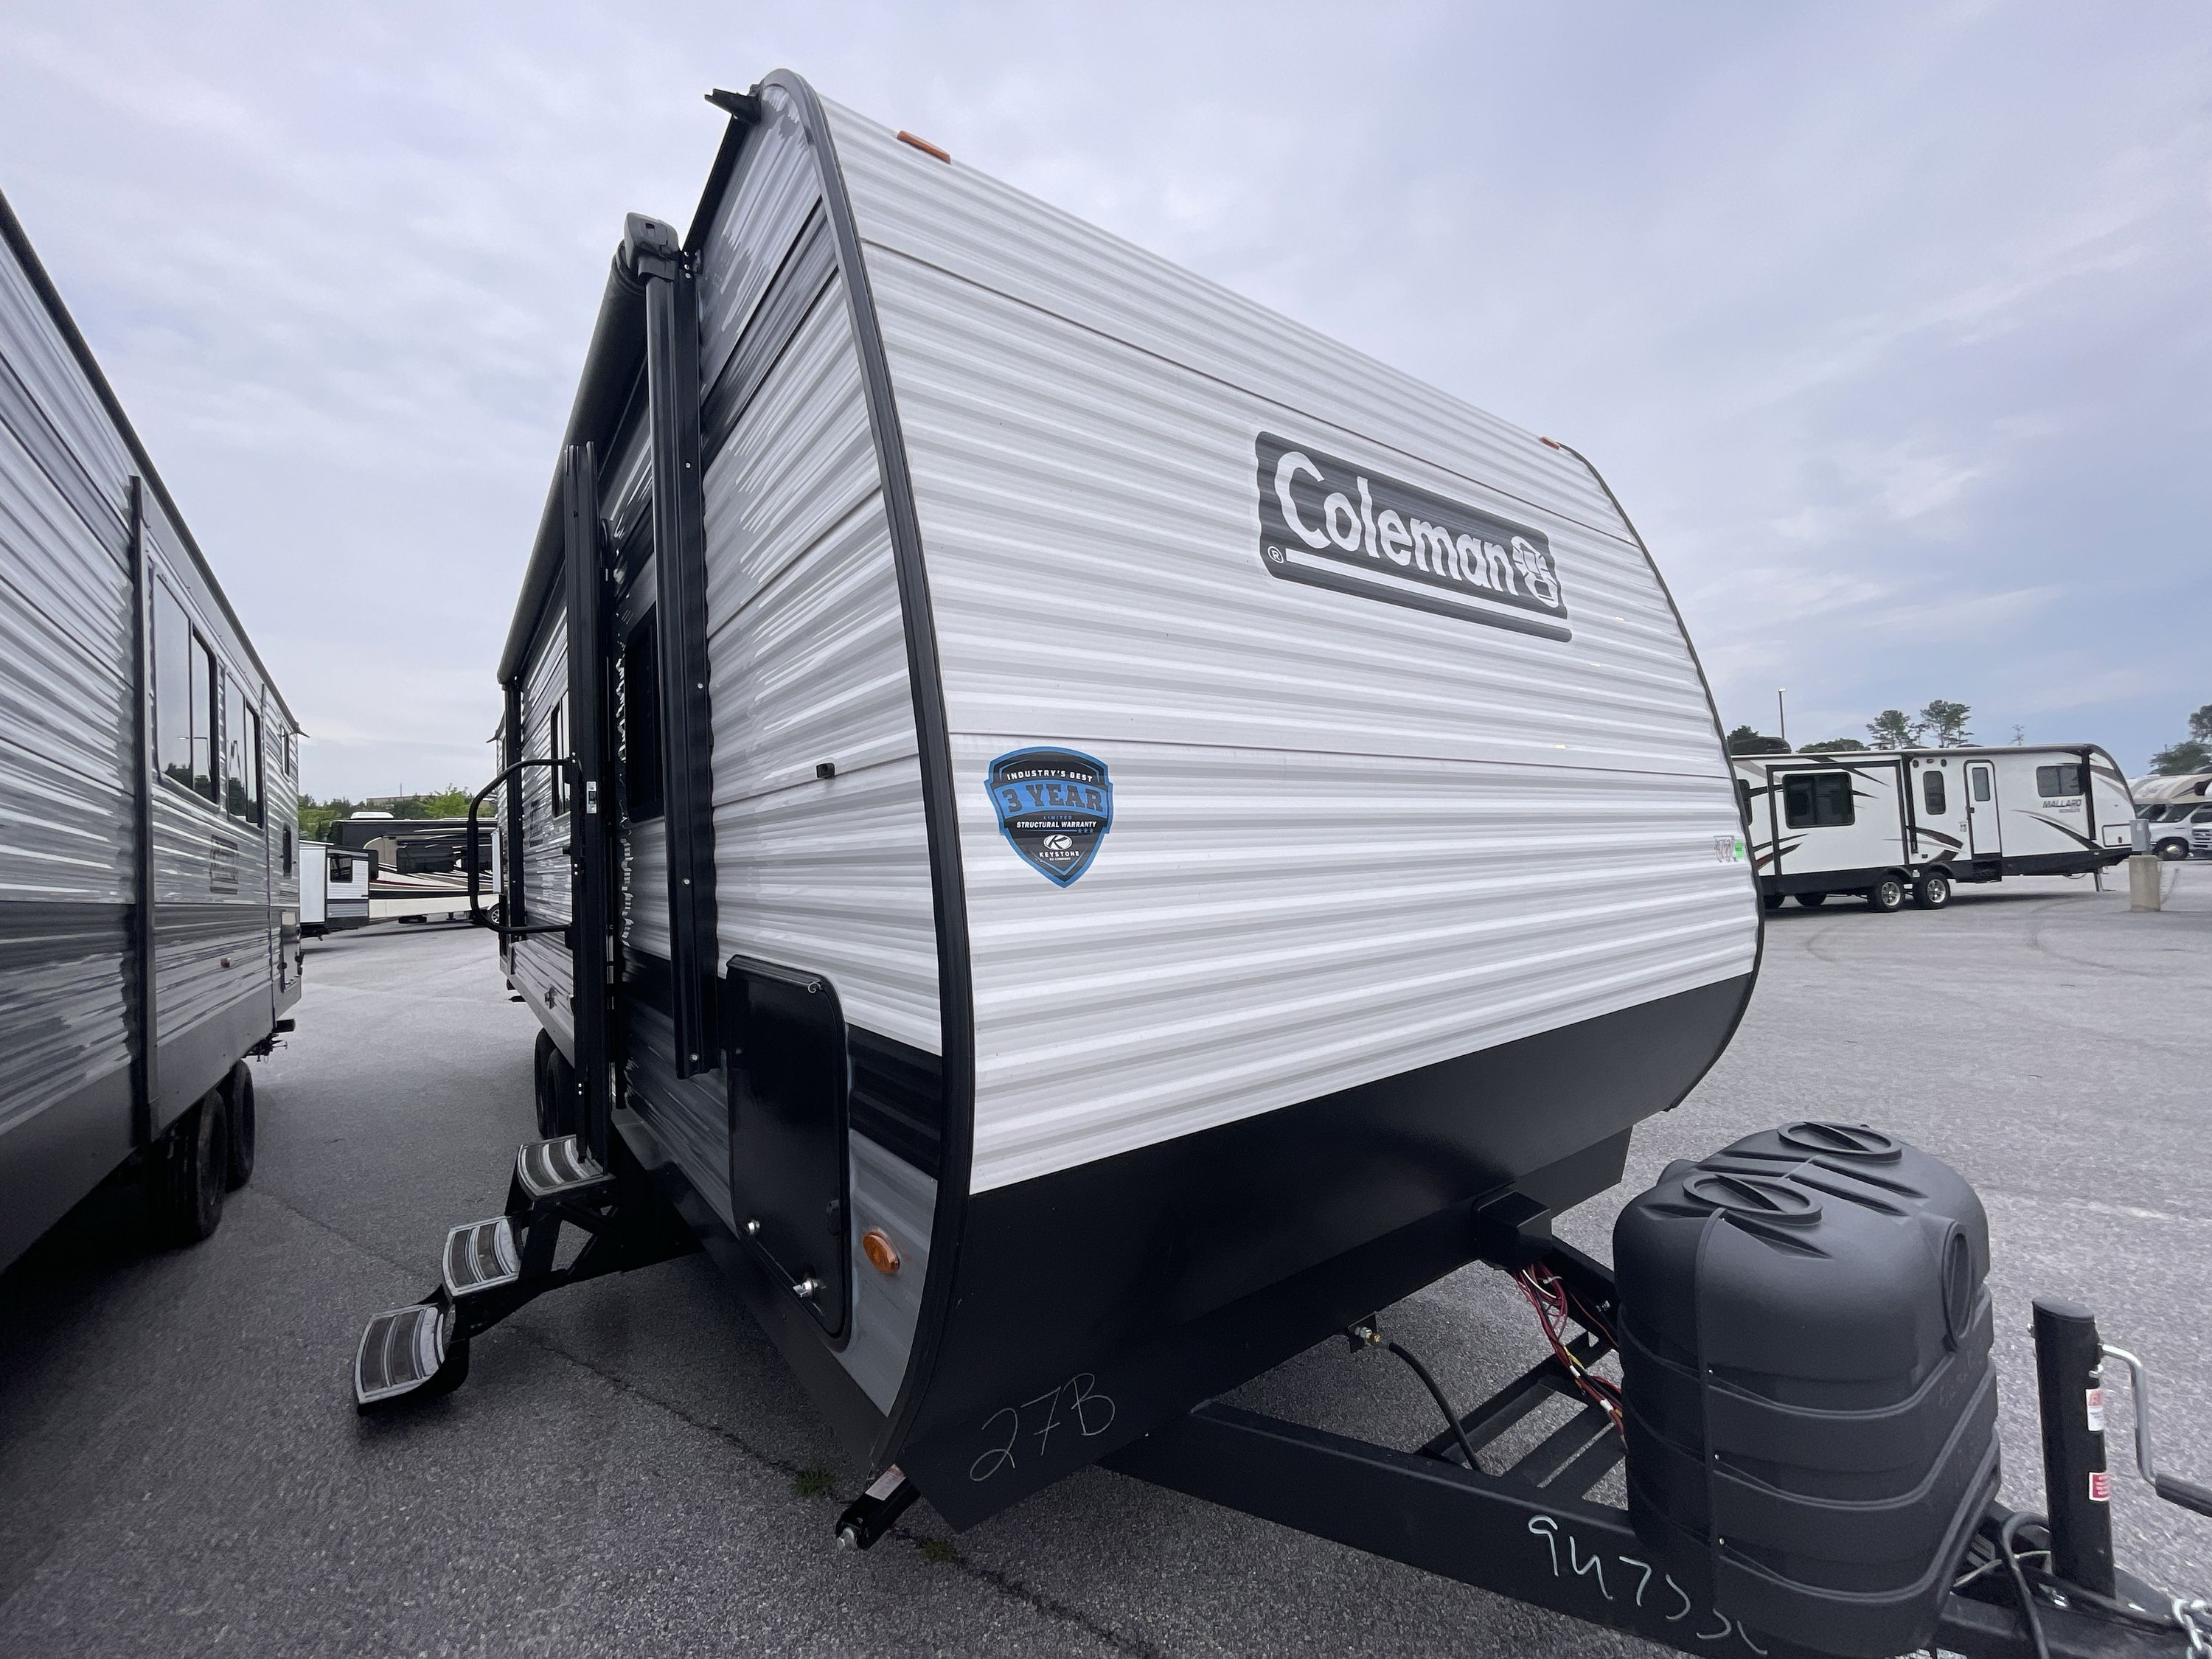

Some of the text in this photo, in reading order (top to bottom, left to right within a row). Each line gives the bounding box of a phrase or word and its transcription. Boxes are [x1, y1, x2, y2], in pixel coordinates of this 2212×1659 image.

[1274, 451, 1519, 597] Coleman
[1001, 783, 1104, 813] 3 YEAR
[1006, 769, 1093, 782] INDUSTRY'S BEST
[970, 1373, 1115, 1481] 27B
